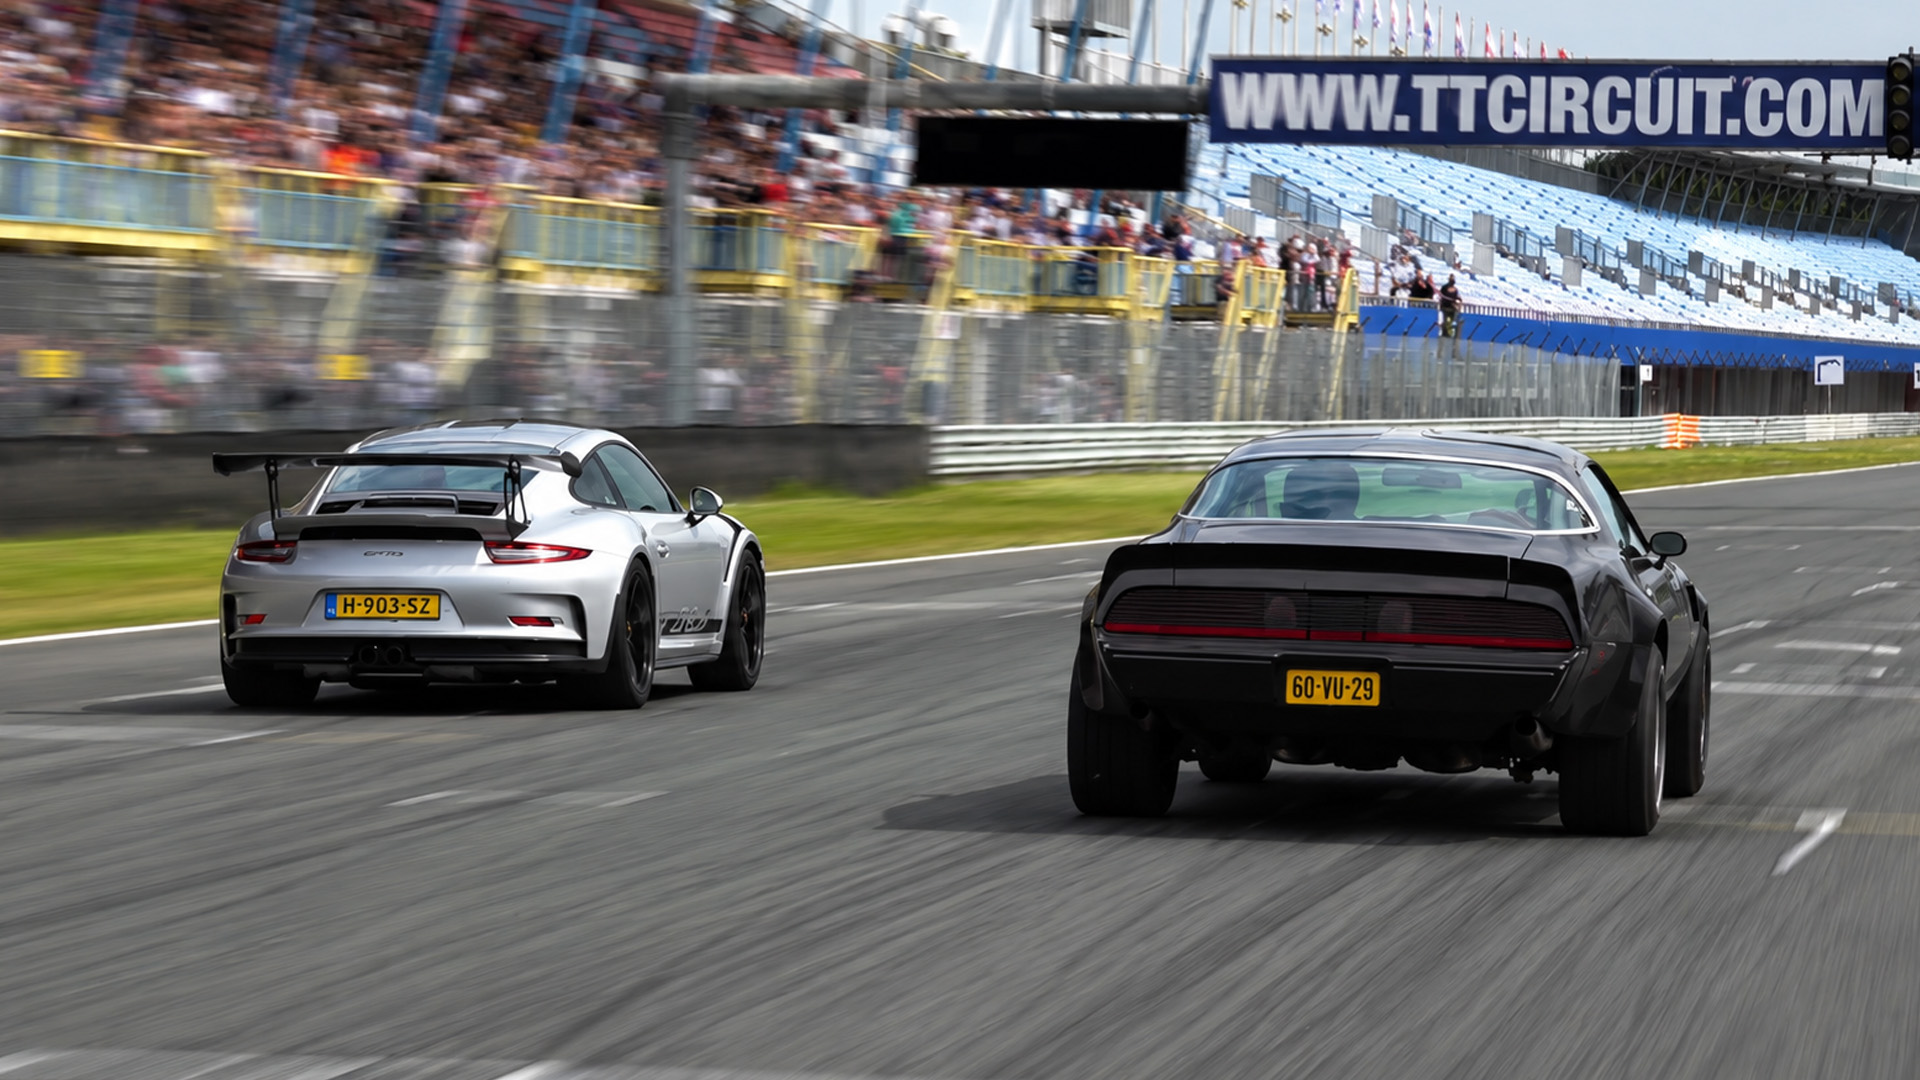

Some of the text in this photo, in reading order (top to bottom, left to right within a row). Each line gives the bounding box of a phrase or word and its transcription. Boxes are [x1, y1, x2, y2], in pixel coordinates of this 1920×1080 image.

[1219, 72, 1885, 137] WWW.TTCIRCUIT.COM
[343, 597, 430, 614] H-903-SZ
[1292, 675, 1373, 700] 60-VU-29
